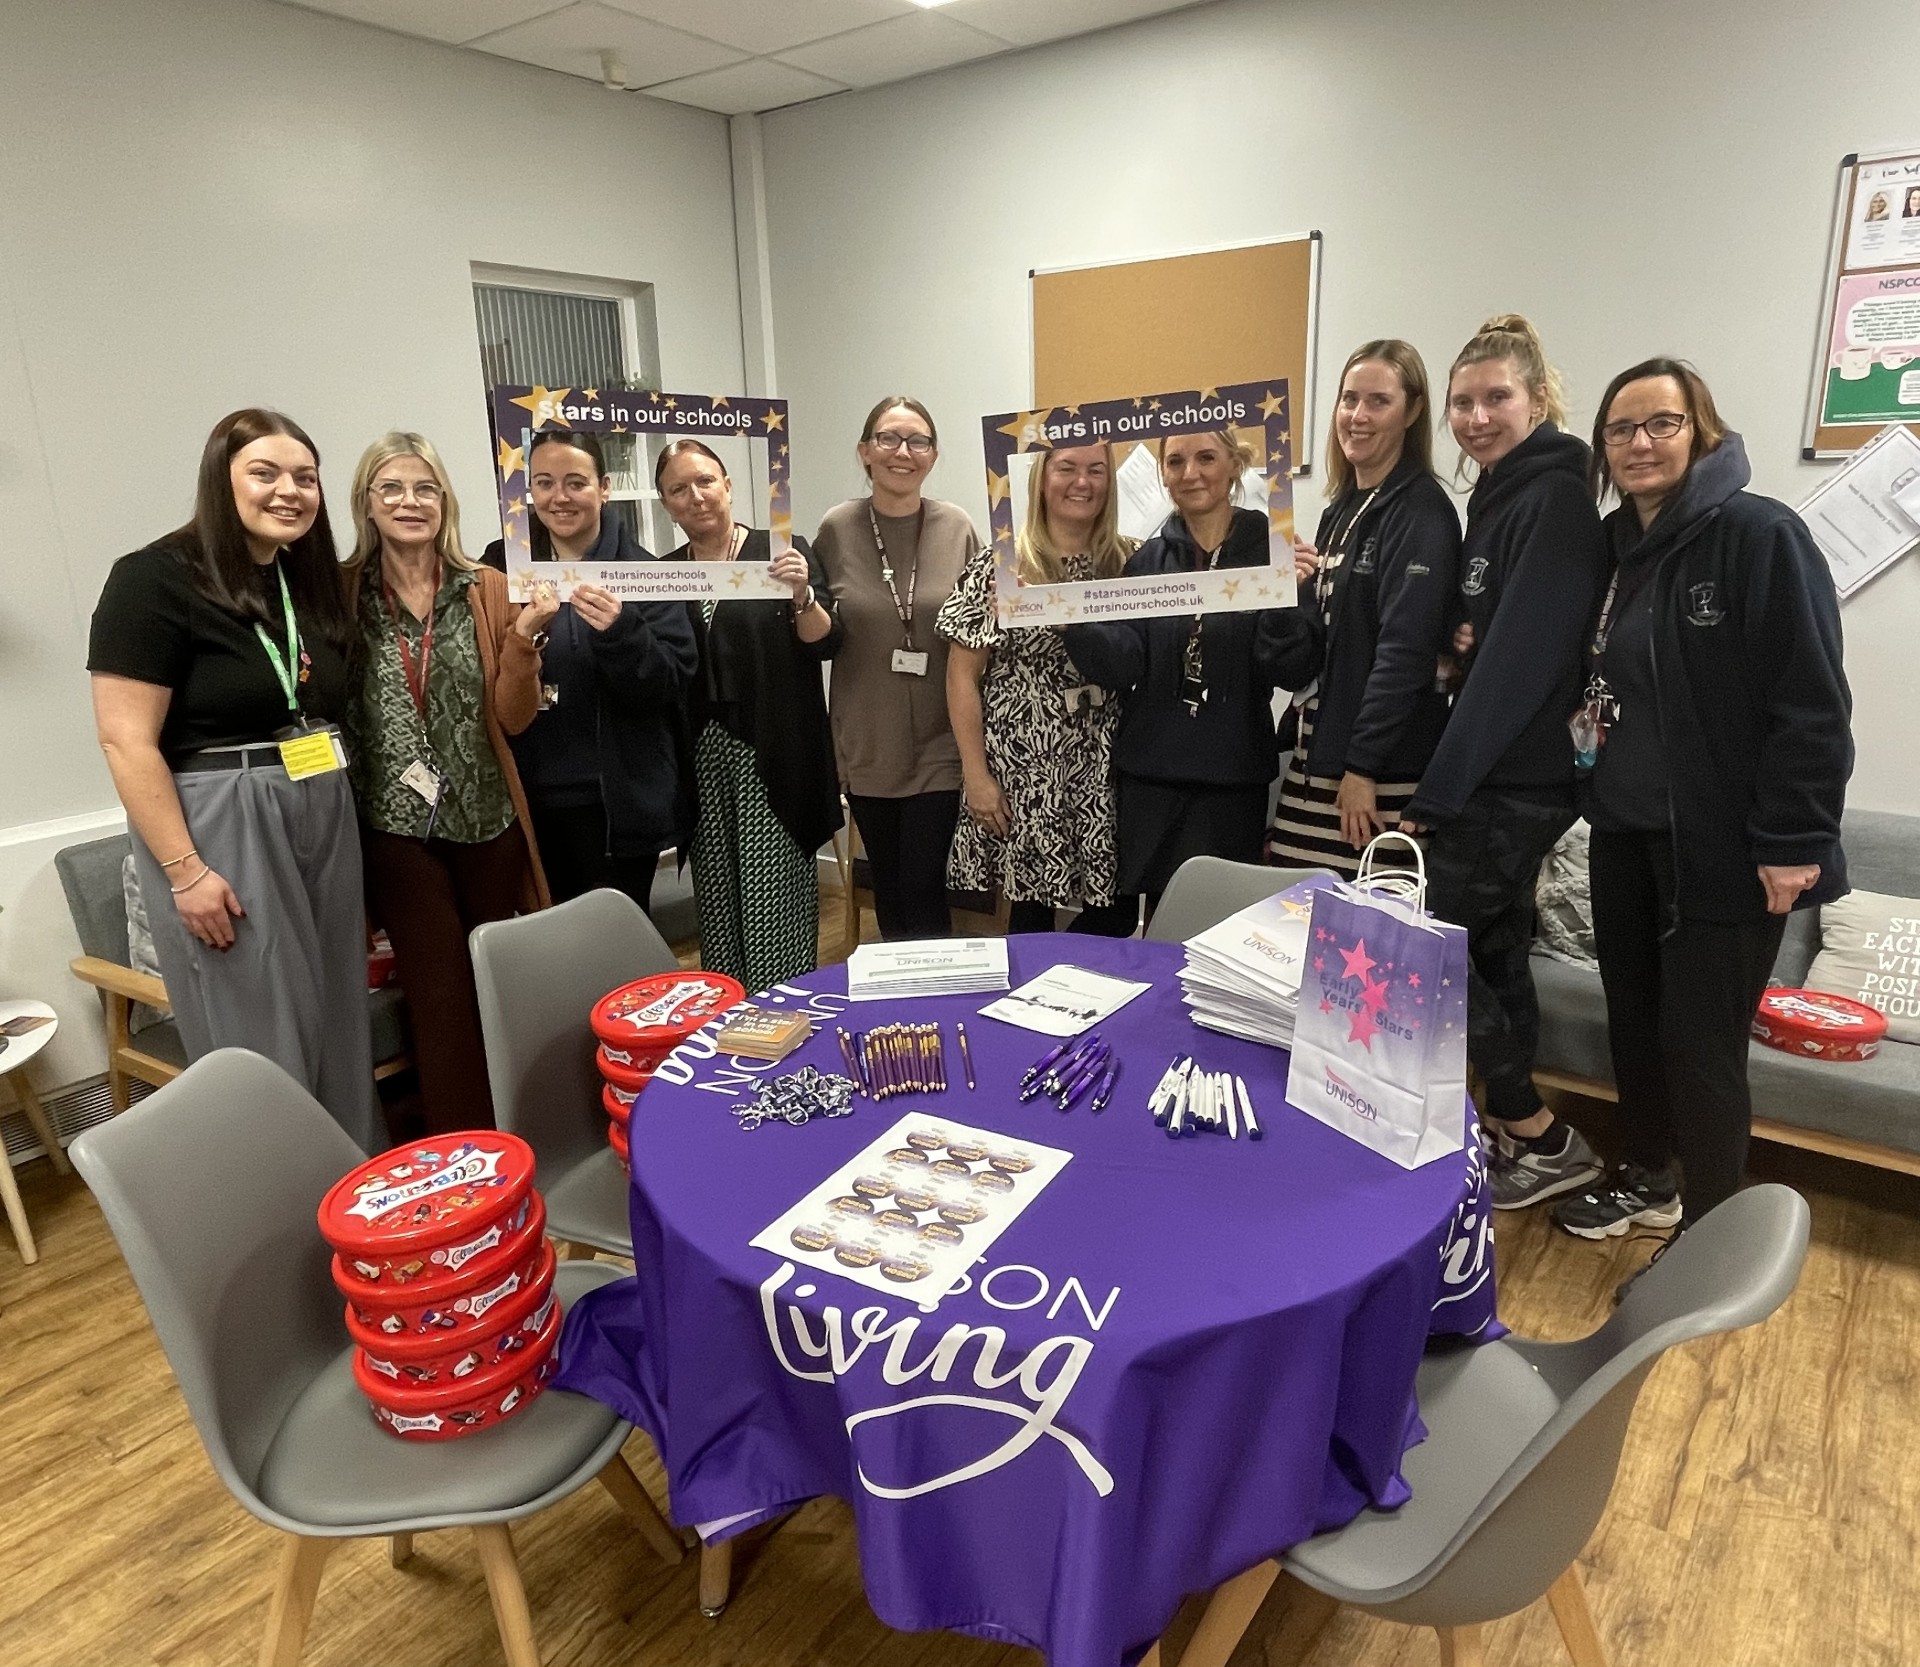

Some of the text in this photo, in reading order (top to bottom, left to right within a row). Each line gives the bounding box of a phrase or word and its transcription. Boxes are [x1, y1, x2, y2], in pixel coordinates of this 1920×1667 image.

[538, 400, 753, 428] Stars in our schools
[1022, 399, 1246, 442] Stars in our schools
[600, 570, 707, 580] #starsinourschools
[602, 582, 714, 593] tarsinourschools.uk
[1083, 582, 1196, 600] #starsinourschools
[1083, 595, 1204, 614] starsinourschools.uk
[897, 957, 953, 966] UNISON
[1243, 937, 1297, 964] UNISON
[1320, 972, 1360, 1000] Early
[1322, 986, 1361, 1014] Years
[1375, 1011, 1413, 1040] Stars
[1325, 1080, 1378, 1120] UNISON
